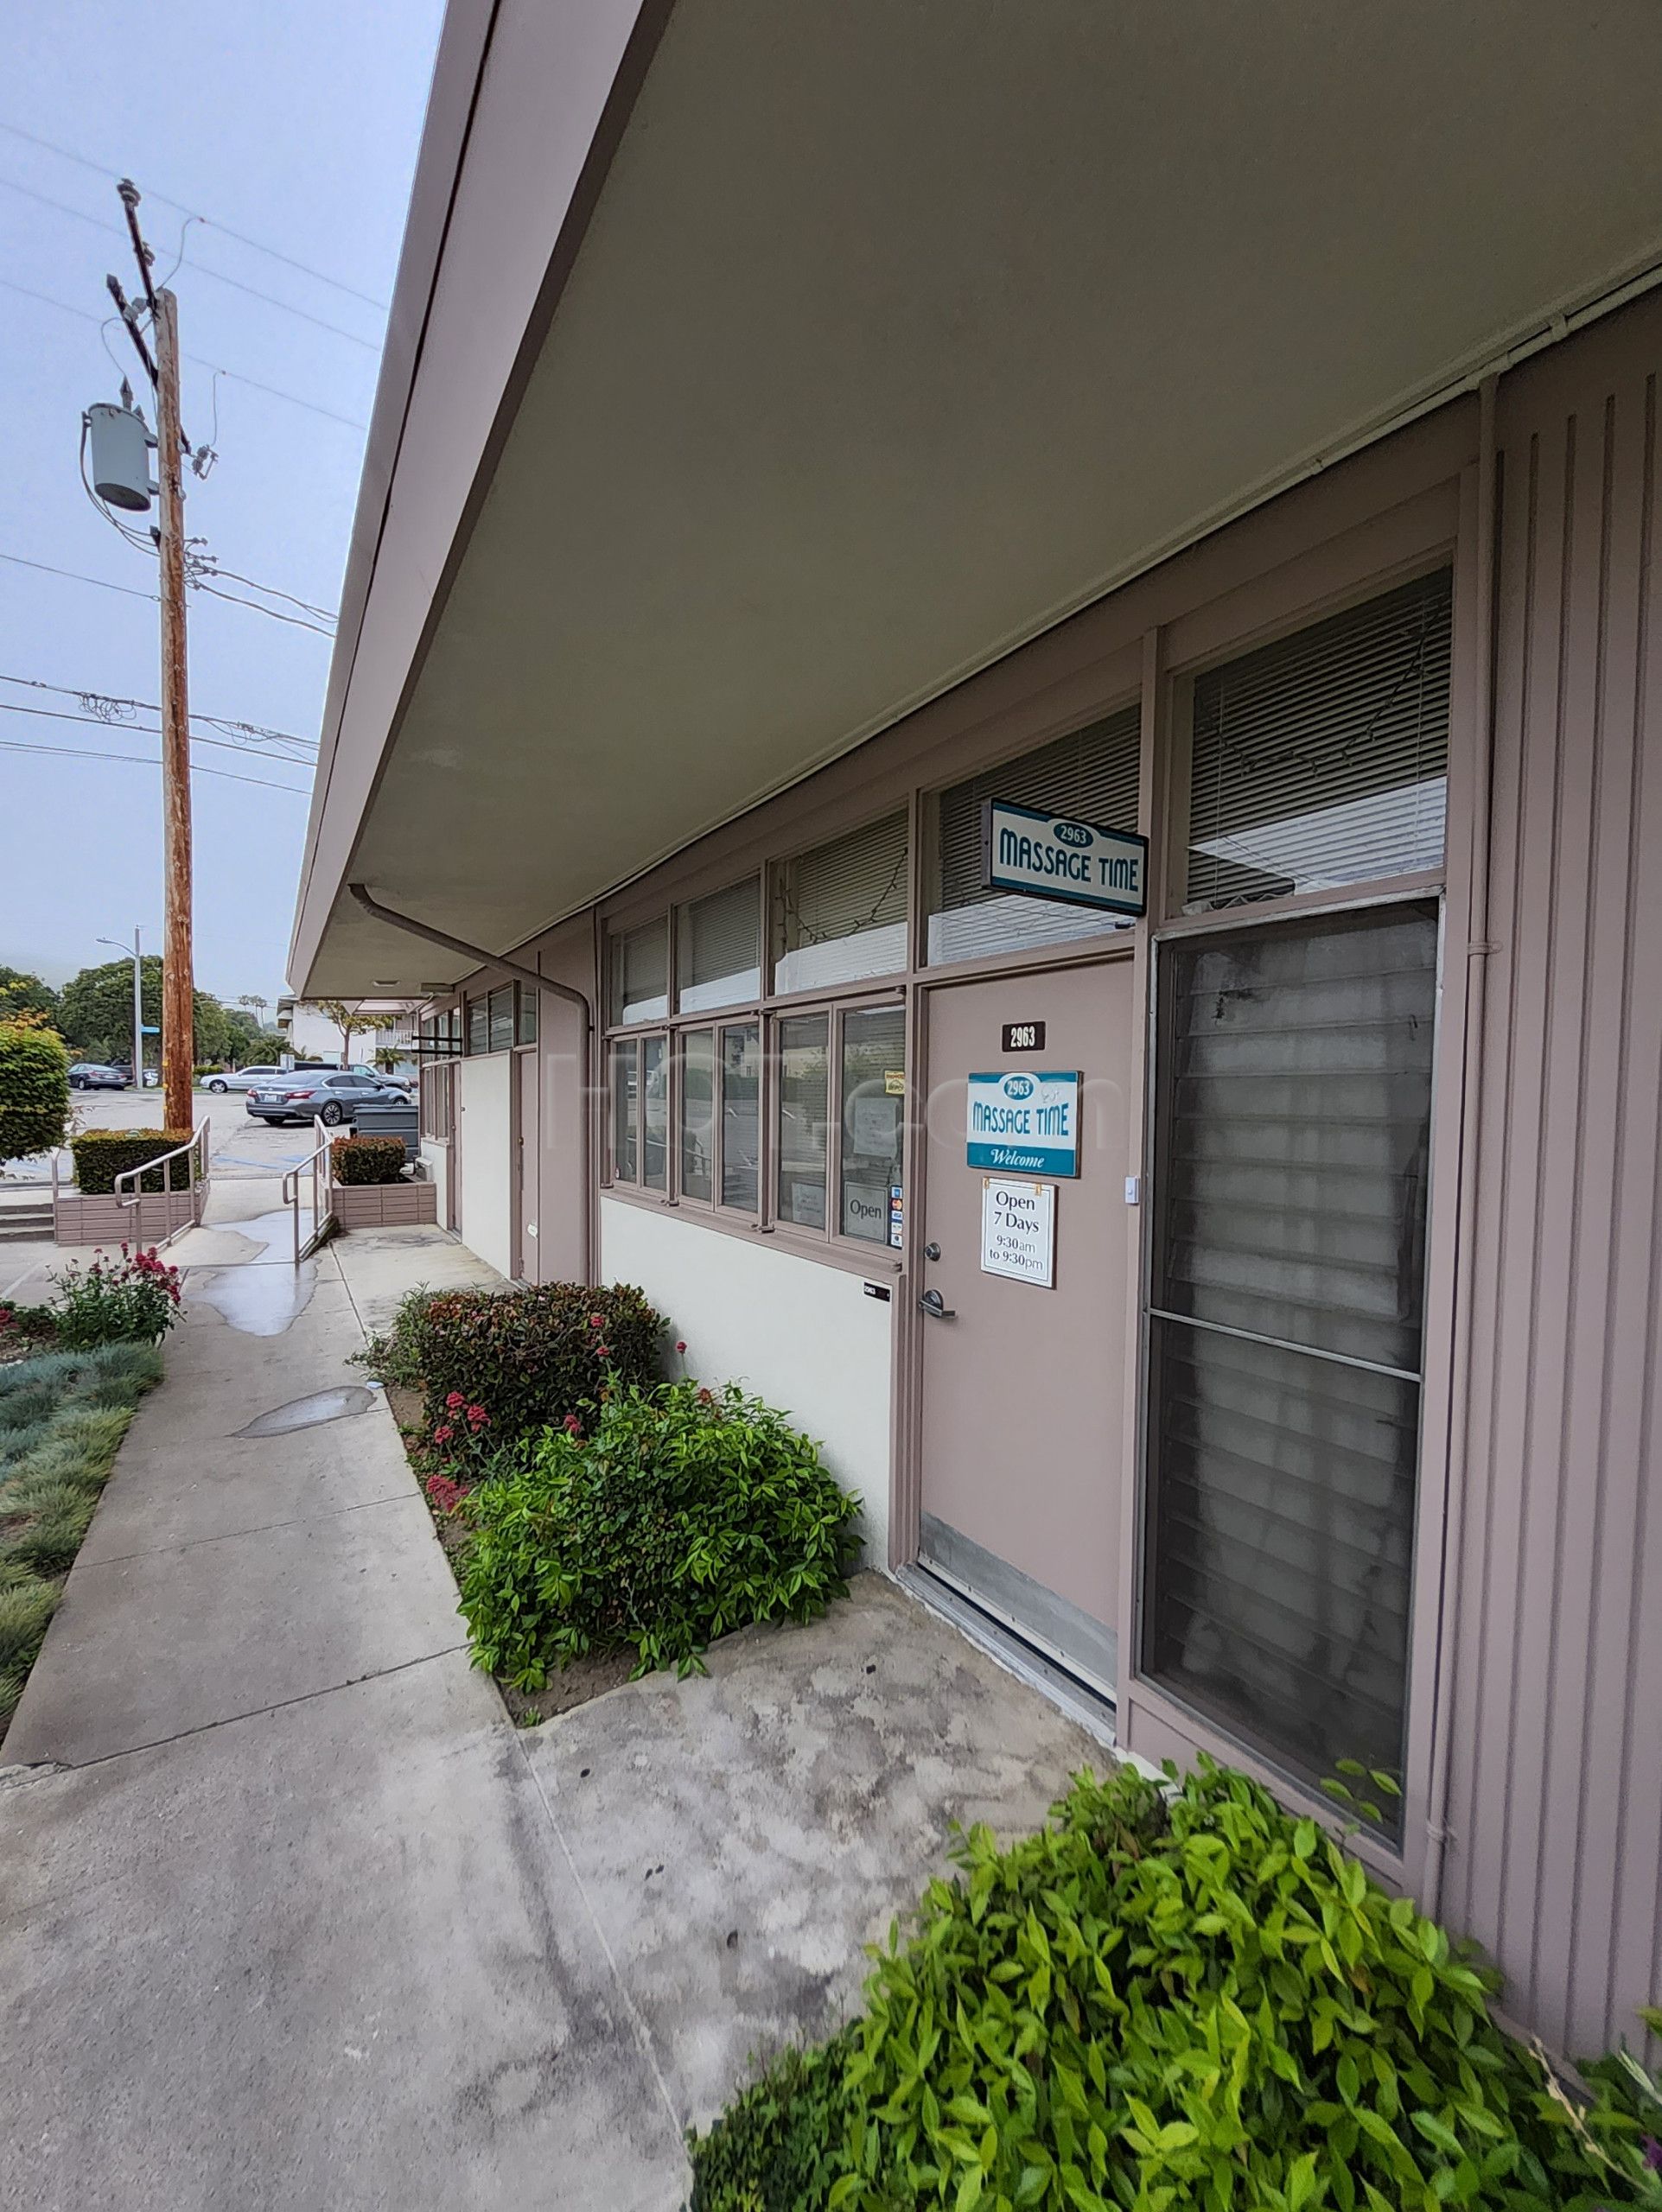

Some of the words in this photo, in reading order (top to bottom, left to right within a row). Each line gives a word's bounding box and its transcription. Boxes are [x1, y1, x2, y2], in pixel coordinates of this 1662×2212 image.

[1060, 825, 1087, 843] 2963
[999, 827, 1092, 883] MASSAGE
[1098, 857, 1139, 893] TIME
[1010, 1025, 1035, 1048] 2963
[1007, 1081, 1030, 1096] 2963
[973, 1101, 1031, 1135] MASSAGE
[1036, 1103, 1069, 1136] TIME
[990, 1148, 1045, 1168] Welcome
[850, 1198, 882, 1219] Open
[996, 1191, 1035, 1211] Open
[994, 1211, 1003, 1225] 7
[1005, 1212, 1040, 1235] Days
[997, 1235, 1035, 1254] 9:30am
[990, 1249, 1000, 1260] to
[1003, 1251, 1043, 1270] 9:30pm
